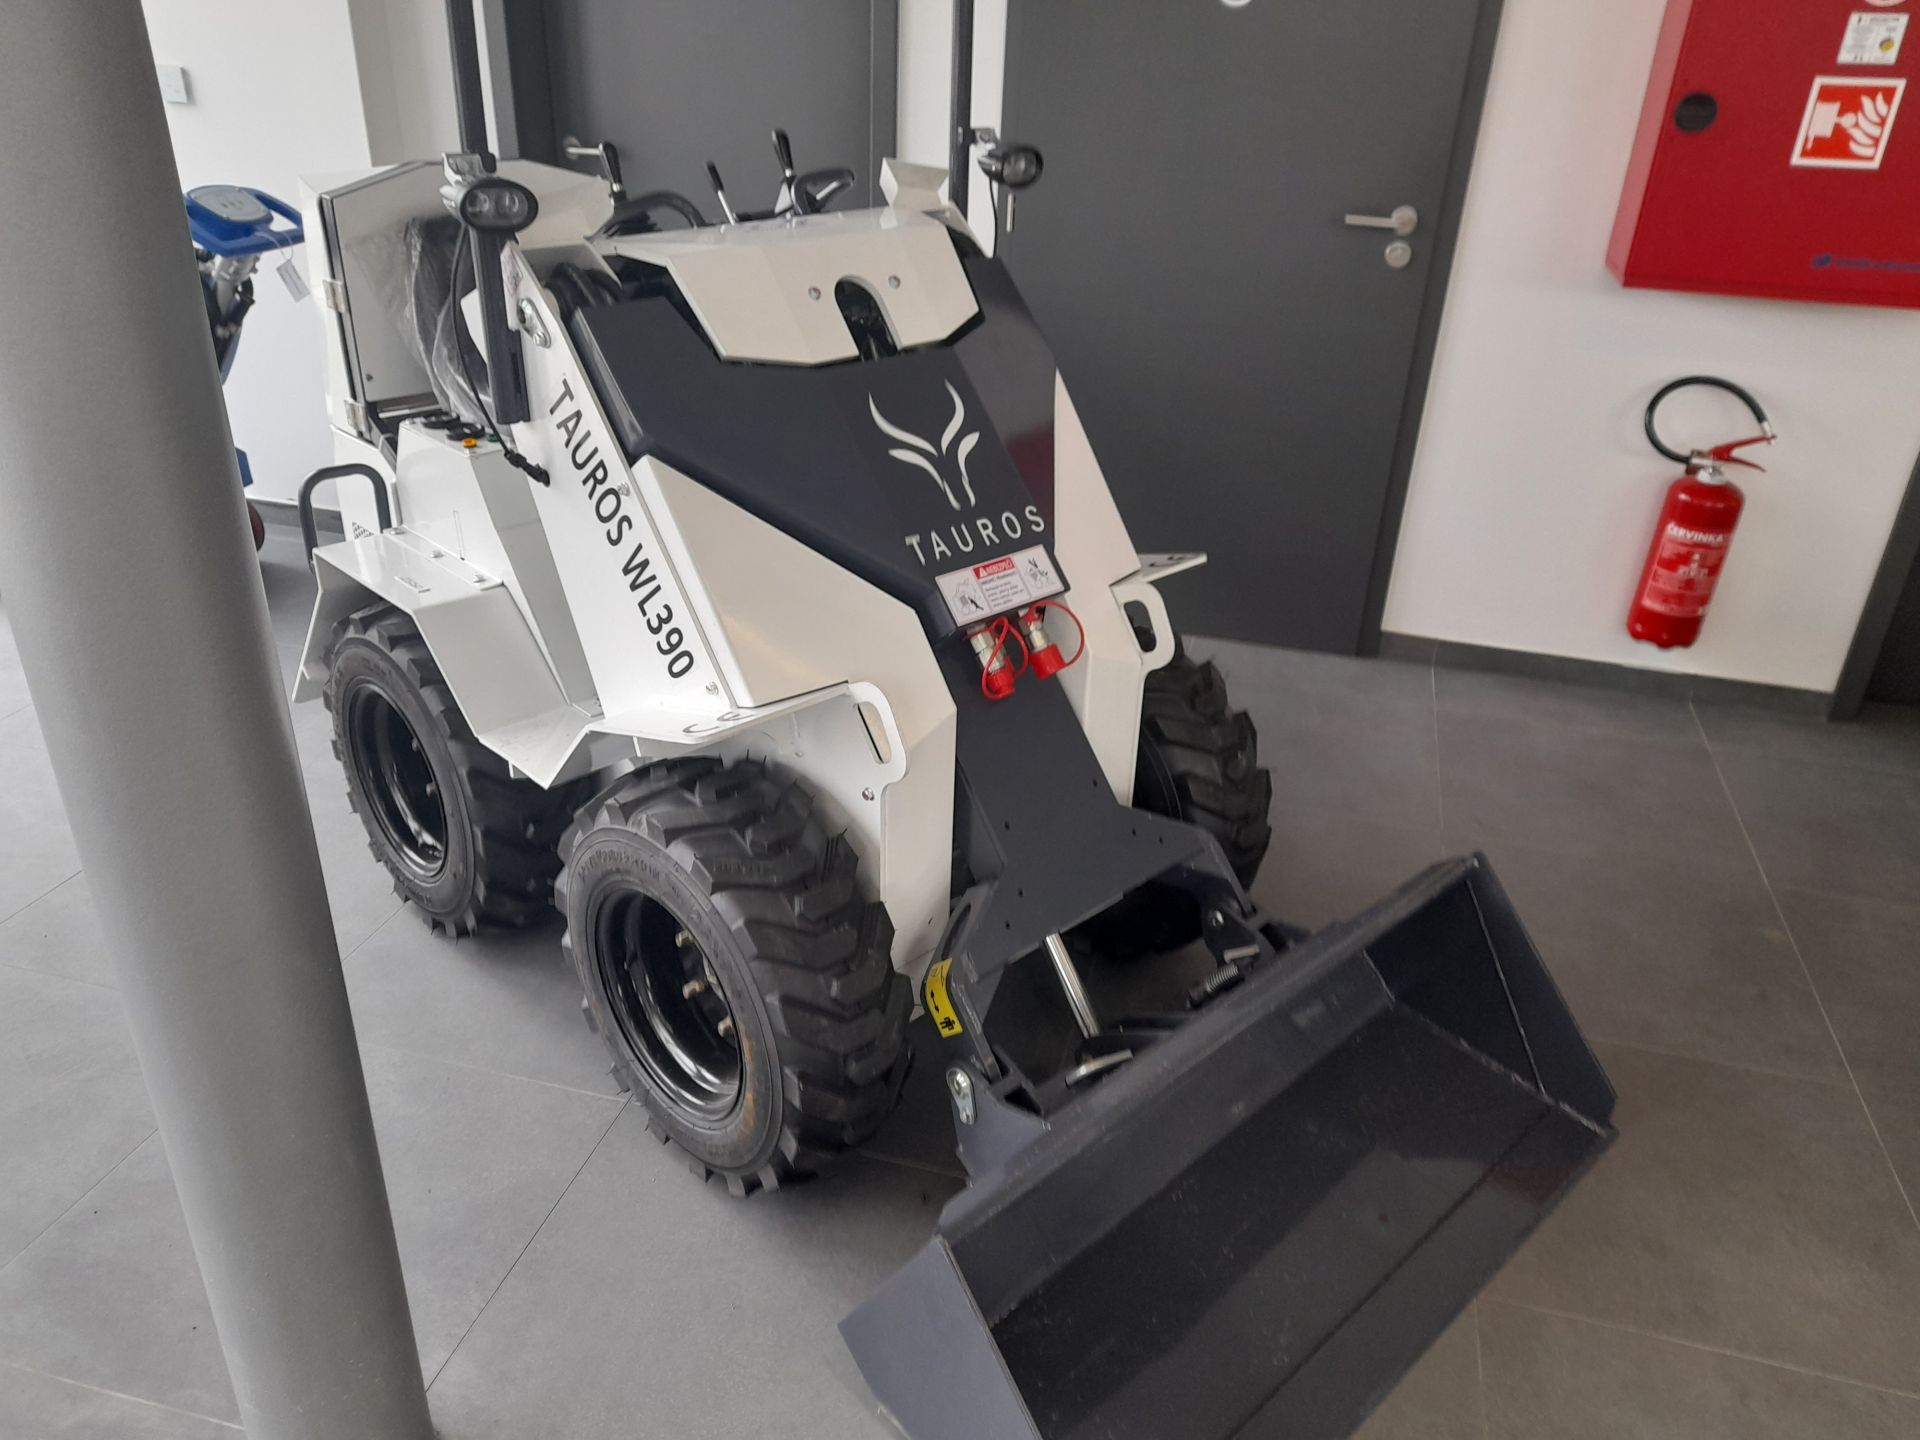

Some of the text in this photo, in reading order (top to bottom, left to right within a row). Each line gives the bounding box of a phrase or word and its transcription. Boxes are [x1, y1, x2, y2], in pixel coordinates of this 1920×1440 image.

[549, 378, 694, 679] TAUROS WL390
[905, 505, 1045, 567] TAUROS
